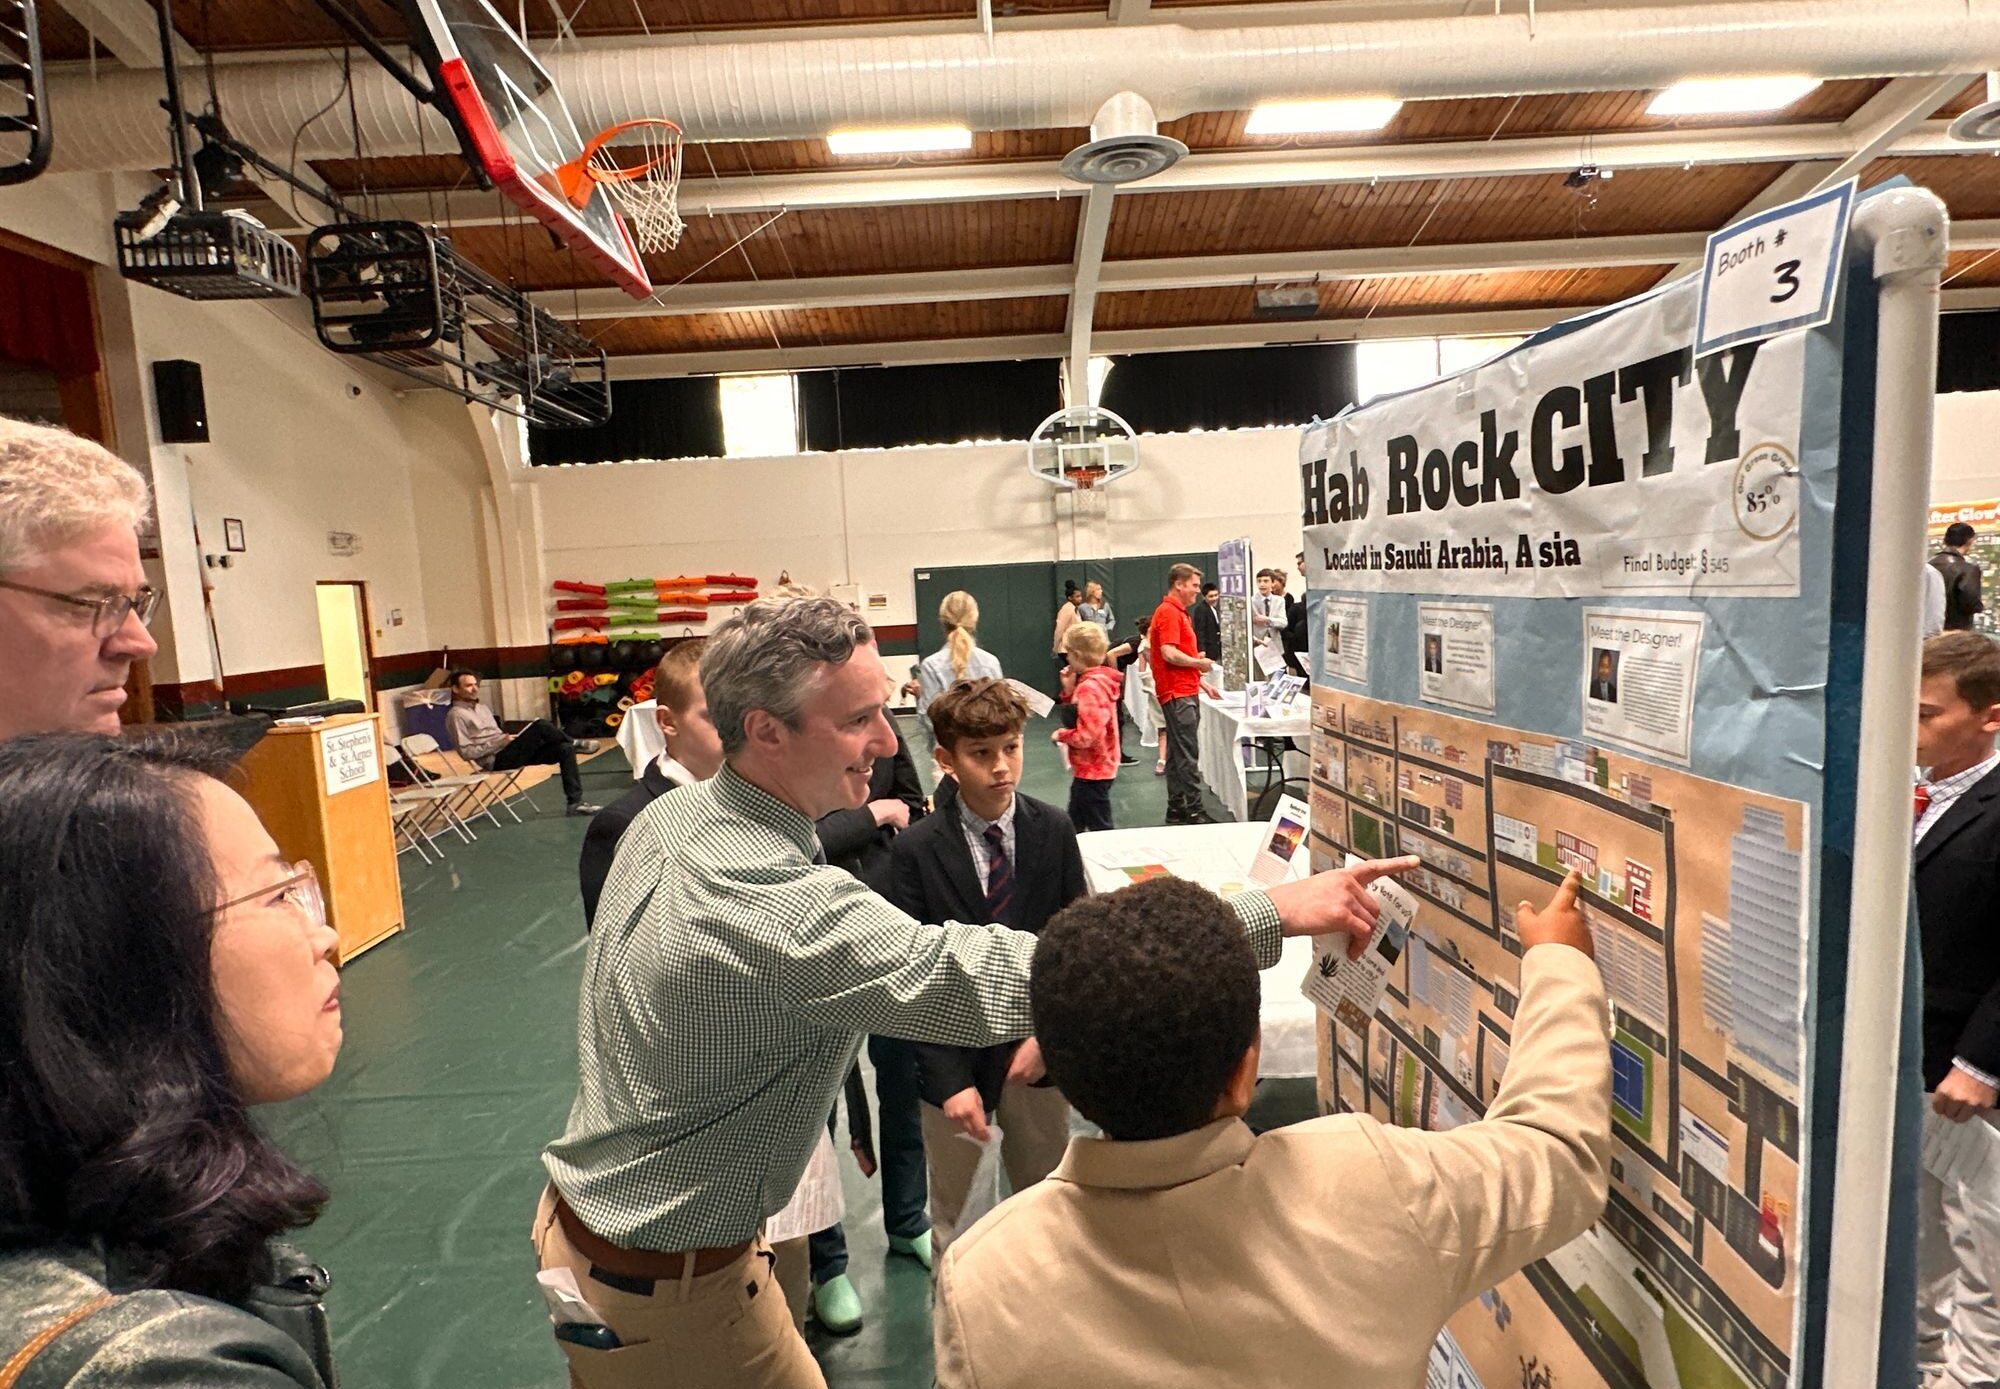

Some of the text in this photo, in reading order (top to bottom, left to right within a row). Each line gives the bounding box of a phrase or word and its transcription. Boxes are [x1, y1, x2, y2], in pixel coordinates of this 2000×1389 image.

[1718, 228, 1788, 276] Booth #
[1770, 259, 1801, 303] 3
[1302, 339, 1768, 526] Hab Rock CITY
[1746, 484, 1780, 513] 85%
[1324, 545, 1367, 571] Located
[1370, 545, 1382, 570] in
[1385, 541, 1432, 570] Saudi
[1437, 537, 1508, 574] Arabia,
[1624, 553, 1652, 573] Final
[1591, 626, 1682, 649] Meet the Designer!
